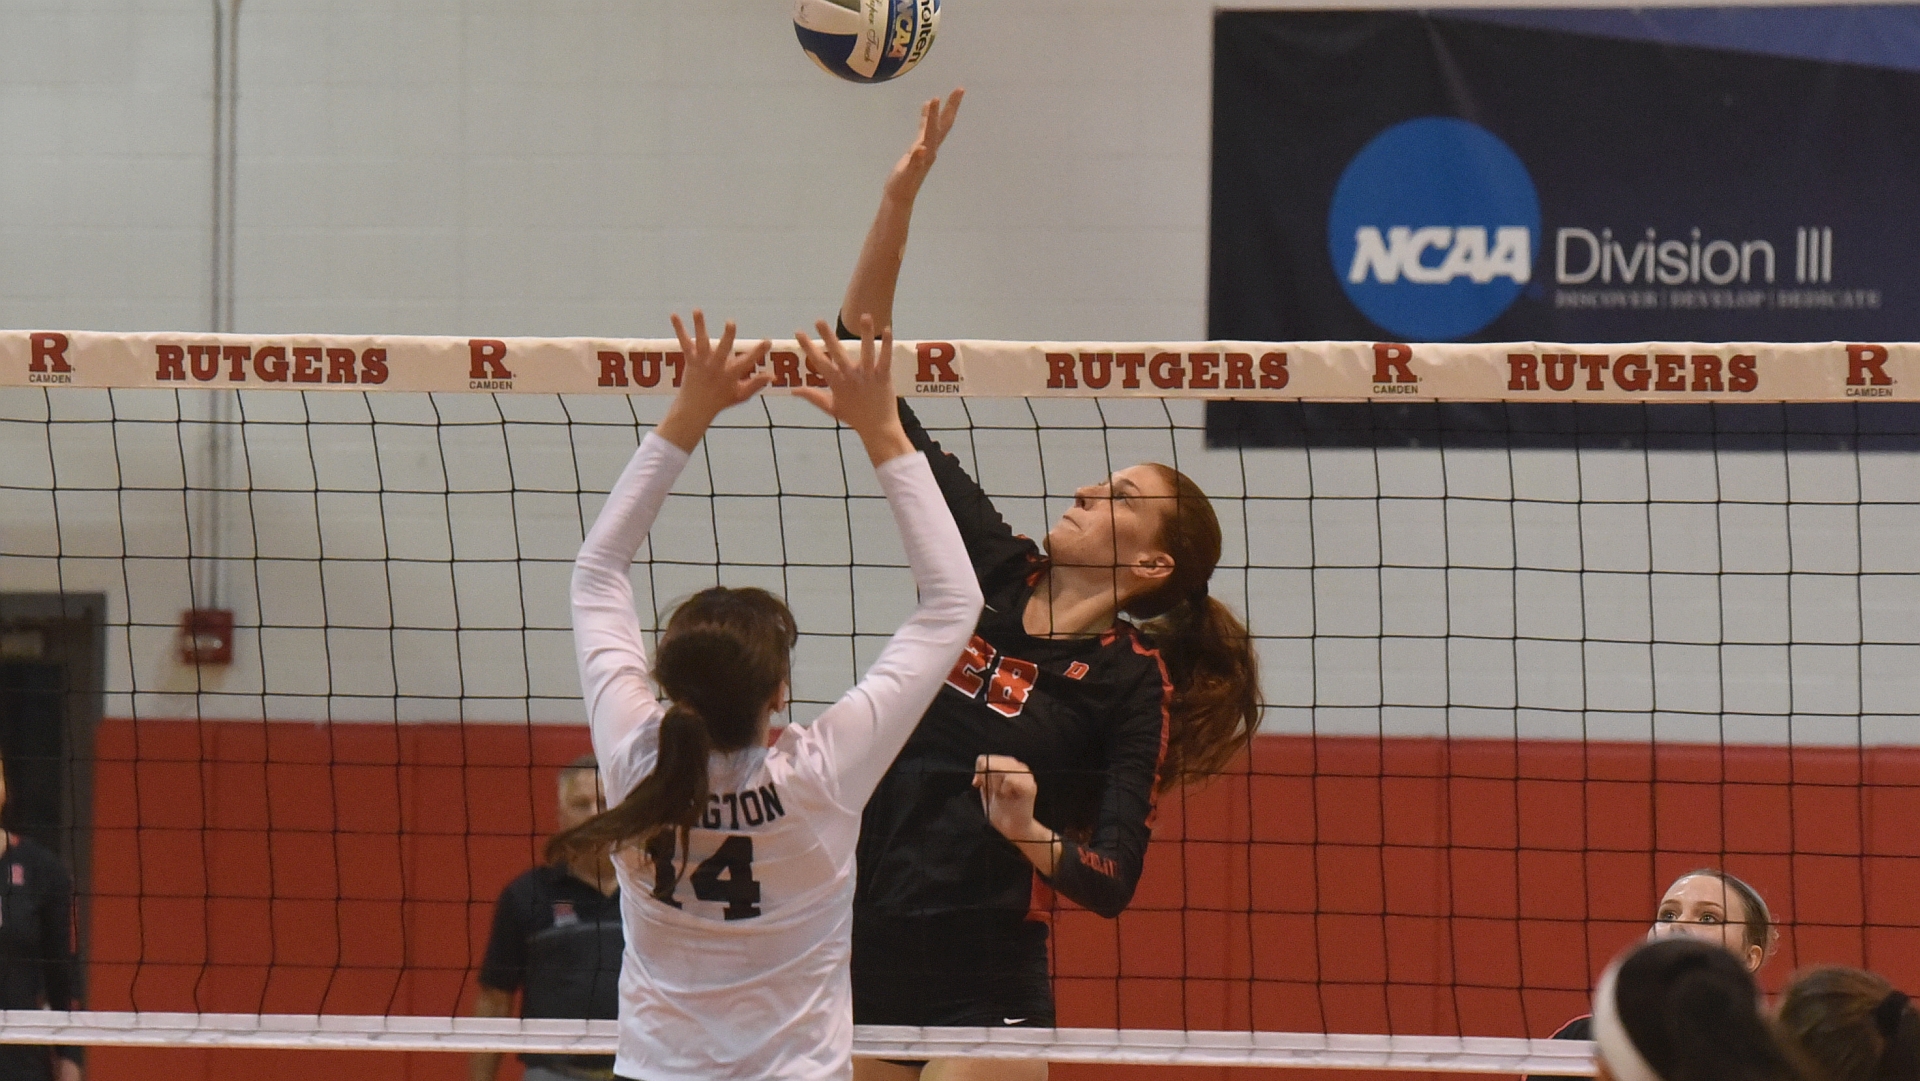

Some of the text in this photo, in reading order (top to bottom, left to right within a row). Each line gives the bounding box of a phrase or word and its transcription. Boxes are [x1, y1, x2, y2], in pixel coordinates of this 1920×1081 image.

[887, 0, 914, 58] NCAA
[1348, 226, 1531, 284] NCAA
[1555, 226, 1834, 285] Division III
[29, 332, 71, 373] R
[155, 344, 389, 384] RUTGERS
[468, 339, 512, 379] R
[597, 351, 833, 387] RUTRS
[915, 342, 960, 382] R
[1045, 353, 1290, 389] RUTGERS
[1372, 343, 1418, 383] R
[1845, 344, 1893, 386] R
[29, 374, 72, 383] CAMDEN
[469, 381, 512, 390] CAMDEN
[915, 384, 960, 393] CAMDEN
[1373, 385, 1418, 394] CAMDEN
[1507, 354, 1759, 392] RUTGERS
[1846, 387, 1893, 397] CAMDEN
[945, 634, 1039, 718] 28
[690, 782, 786, 830] GTON
[645, 828, 762, 920] 14
